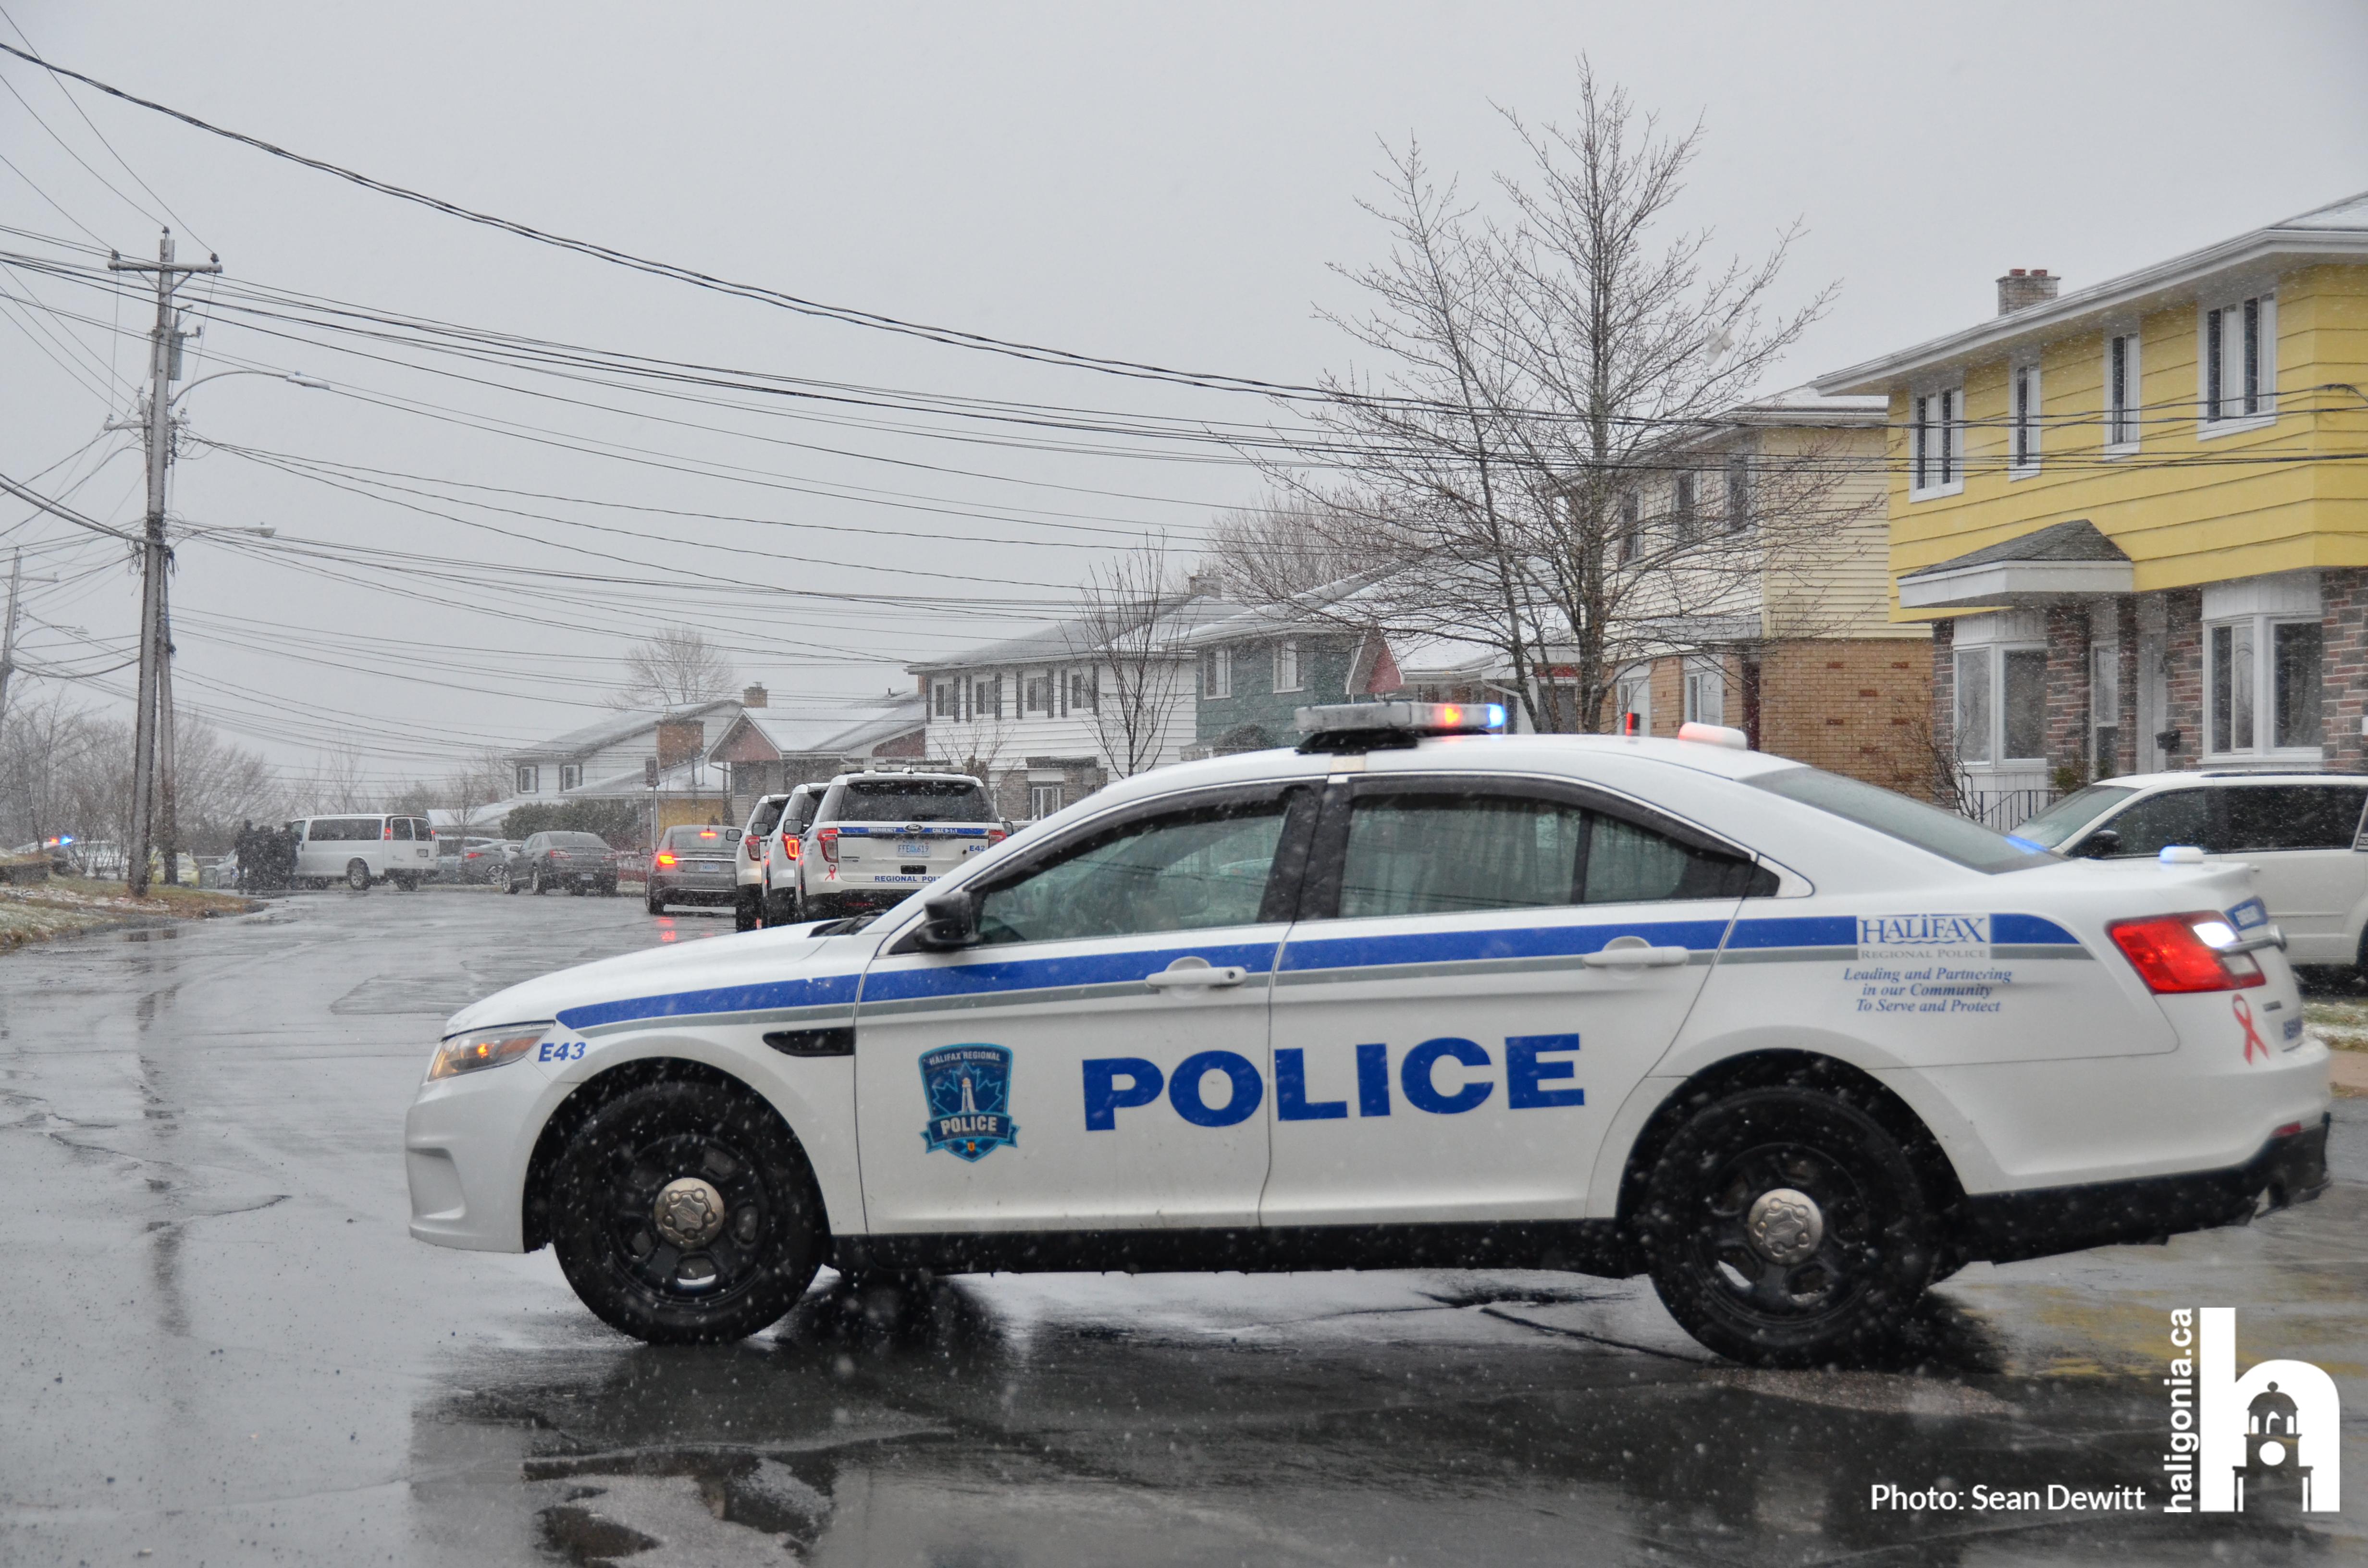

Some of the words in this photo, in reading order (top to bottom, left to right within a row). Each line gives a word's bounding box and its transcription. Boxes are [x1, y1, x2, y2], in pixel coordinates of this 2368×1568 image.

[1859, 915, 1986, 943] HALIFAX
[1861, 949, 1932, 959] REGIONAL
[1938, 948, 1986, 958] POLICE
[1843, 968, 1900, 983] Leading
[1904, 968, 1931, 980] and
[1936, 968, 2012, 984] Partnering
[1862, 983, 1876, 996] in
[1880, 986, 1906, 996] our
[1910, 983, 1993, 999] Community
[1857, 999, 1872, 1012] To
[1875, 999, 1916, 1012] Serve
[1919, 999, 1946, 1012] and
[1951, 999, 2001, 1012] Protect
[538, 1041, 587, 1063] E43
[929, 1053, 961, 1066] HALIFAX
[963, 1051, 1000, 1061] REGIONAL
[1082, 1033, 1585, 1131] POLICE
[940, 1115, 998, 1135] POLICE
